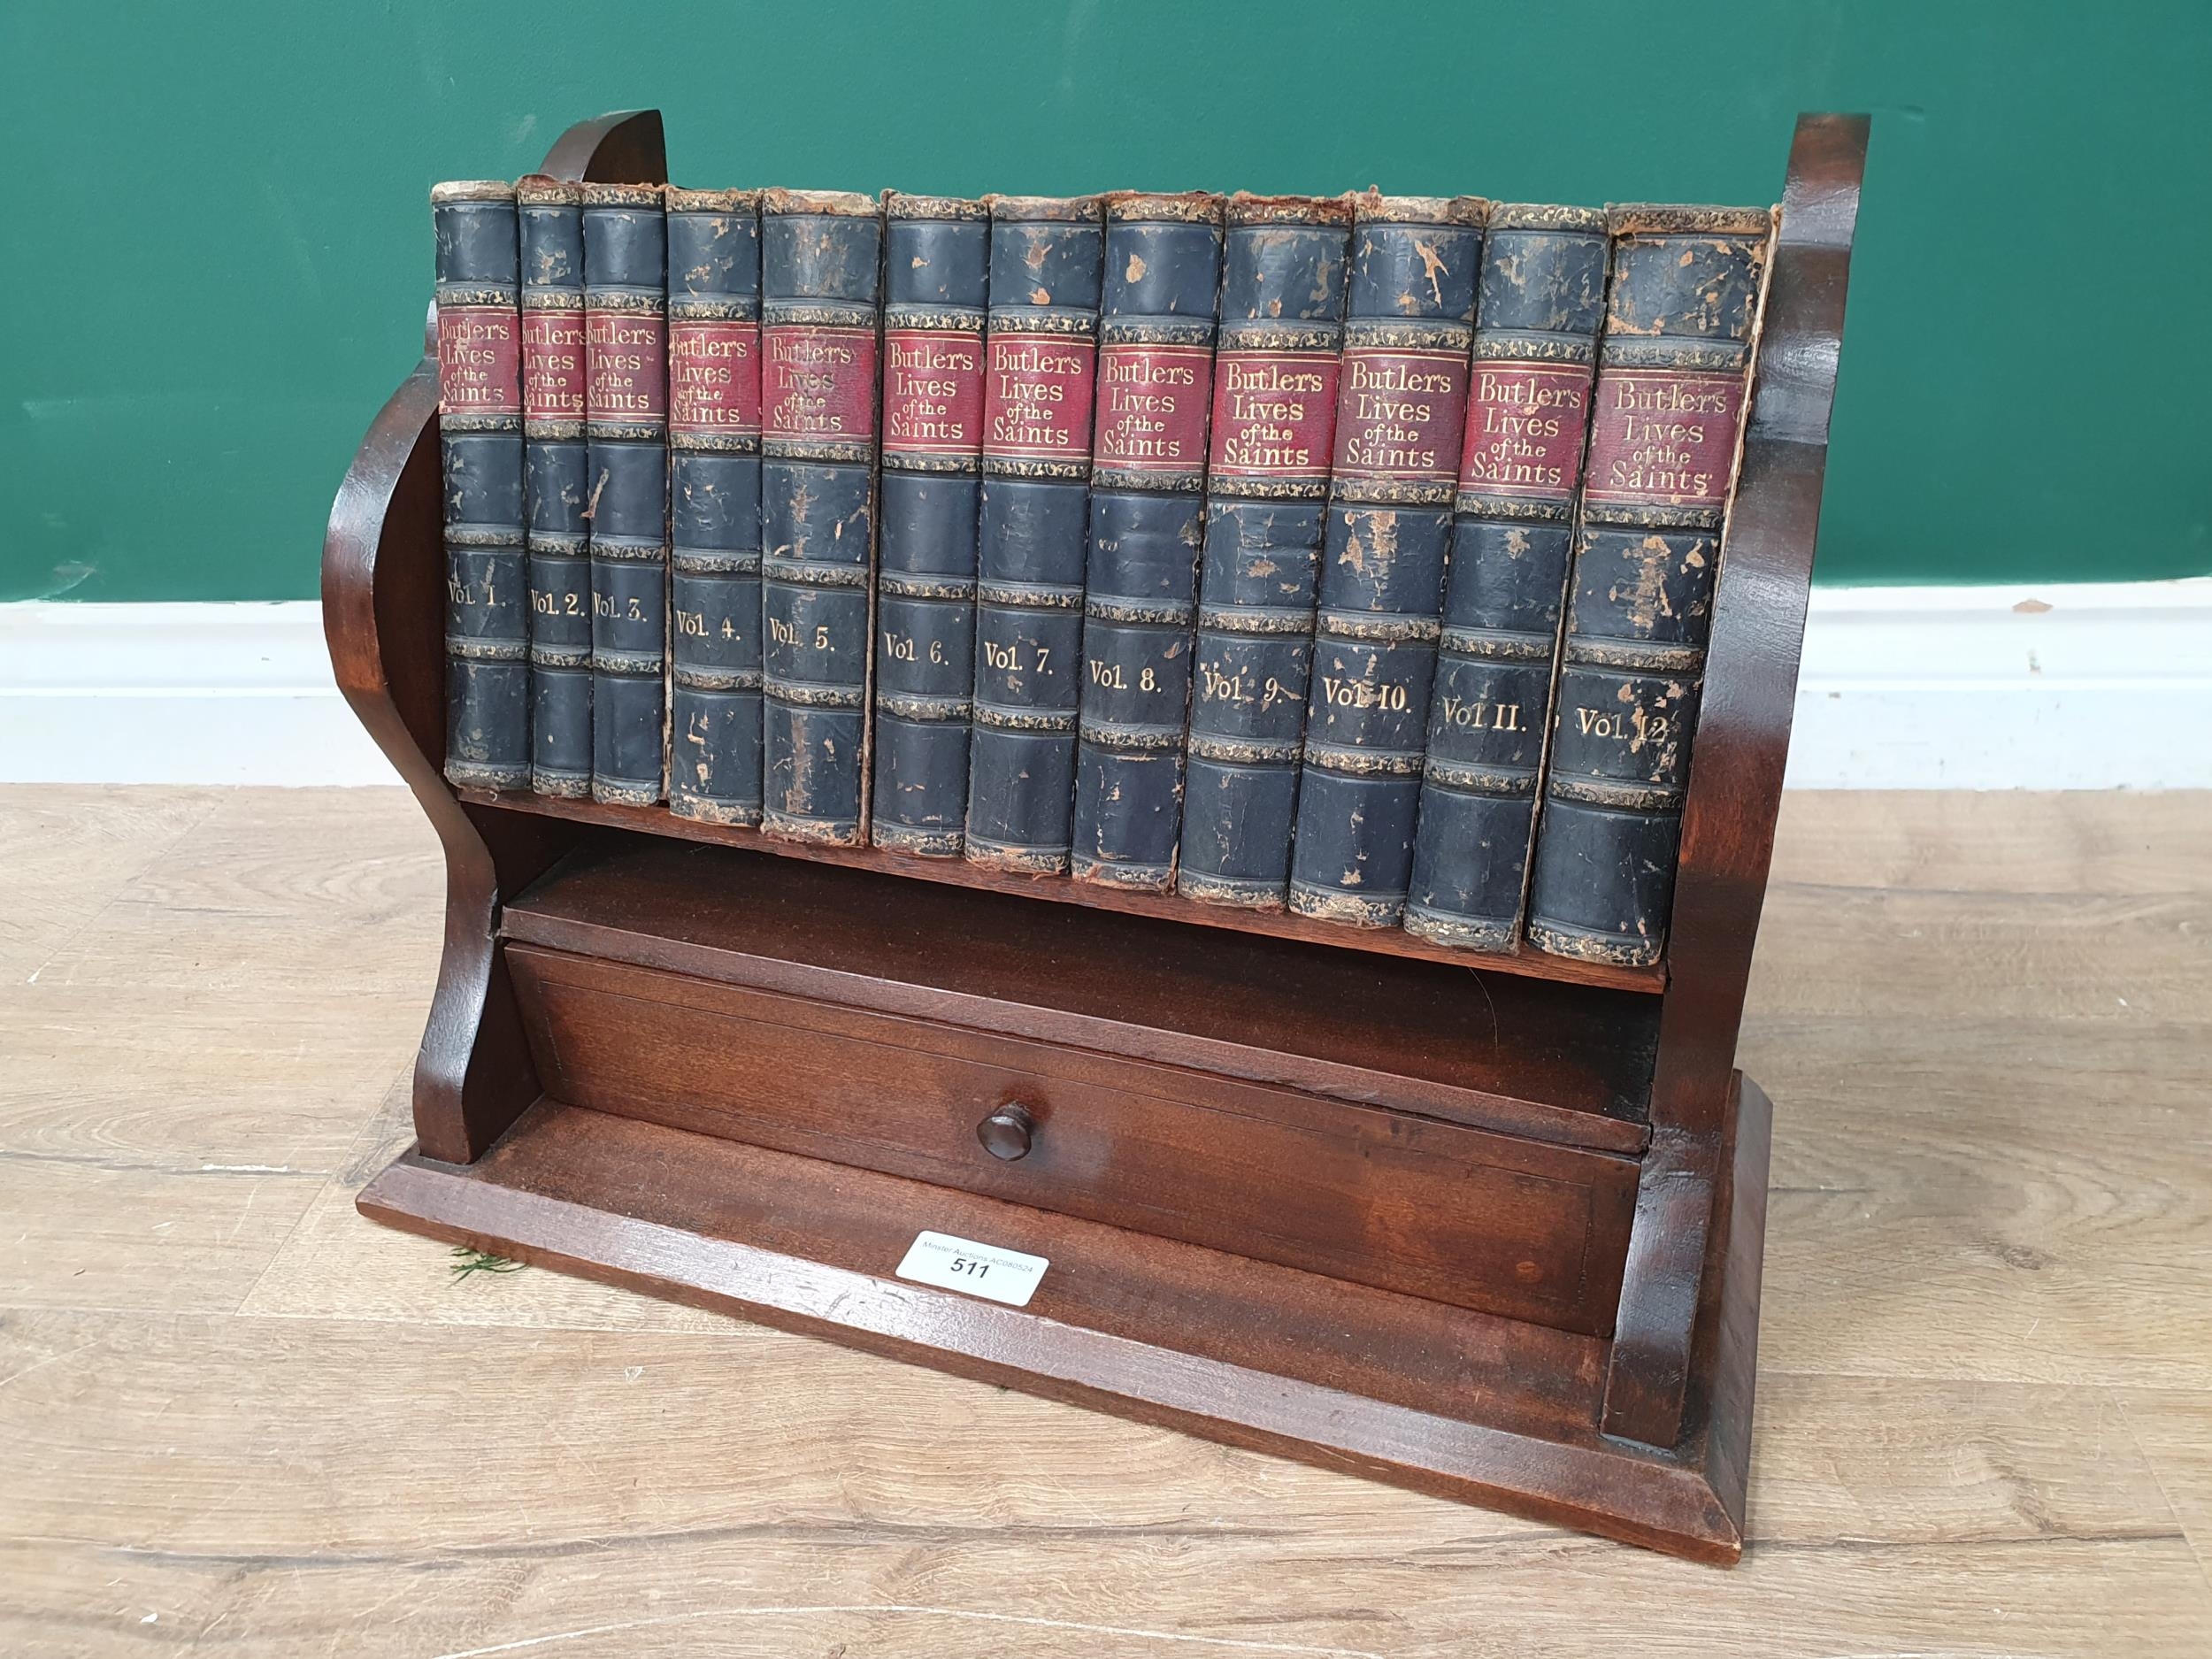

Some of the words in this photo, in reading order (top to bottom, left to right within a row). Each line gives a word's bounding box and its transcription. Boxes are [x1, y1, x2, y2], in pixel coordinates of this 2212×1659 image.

[446, 344, 495, 365] Lives
[525, 348, 574, 370] Lives
[591, 348, 641, 370] Lives
[451, 366, 463, 387] of
[464, 367, 488, 381] the
[528, 373, 541, 391] of
[541, 373, 567, 387] the
[595, 373, 608, 392] of
[608, 373, 634, 387] the
[676, 361, 732, 384] Lives
[779, 366, 834, 390] Lives
[443, 380, 503, 402] Saints
[525, 386, 584, 408] Saints
[696, 385, 723, 401] the
[896, 373, 956, 397] Lives
[1000, 375, 1063, 402] Lives
[589, 386, 649, 409] Saints
[784, 392, 798, 411] of
[799, 393, 826, 409] the
[902, 400, 918, 419] of
[919, 401, 947, 415] the
[1110, 388, 1175, 413] Lives
[1233, 395, 1304, 420] Lives
[1356, 394, 1431, 421] Lives
[673, 398, 741, 423] Saints
[773, 405, 842, 431] Saints
[1007, 403, 1023, 424] of
[1025, 403, 1053, 420] the
[1484, 407, 1559, 437] Lives
[891, 412, 964, 439] Saints
[994, 417, 1069, 445] Saints
[1118, 415, 1135, 437] of
[1136, 416, 1165, 432] the
[1241, 424, 1259, 447] of
[1261, 424, 1293, 441] the
[1364, 424, 1385, 446] of
[1386, 425, 1418, 442] the
[1623, 415, 1704, 442] Lives
[1103, 430, 1180, 457] Saints
[1225, 438, 1309, 465] Saints
[1347, 438, 1434, 467] Saints
[1491, 439, 1512, 461] of
[1513, 440, 1547, 457] the
[1632, 445, 1655, 465] of
[1657, 445, 1691, 464] the
[1471, 452, 1561, 484] Saints
[1610, 460, 1708, 490] Saints
[532, 589, 559, 614] Vol.
[565, 594, 585, 616] 2.
[593, 591, 621, 618] Vol.
[628, 598, 648, 623] 3.
[677, 610, 709, 636] Vol.
[721, 617, 741, 641] 4.
[815, 626, 835, 651] 5.
[930, 641, 949, 665] 6.
[985, 641, 1023, 671] Vol.
[1036, 649, 1053, 675] 7.
[1090, 660, 1127, 689] Vol.
[1141, 668, 1162, 693] 8.
[1263, 677, 1282, 703] 9.
[1576, 708, 1628, 741] Vol.
[922, 1241, 954, 1254] Minster
[953, 1248, 988, 1263] Auctions
[950, 1257, 990, 1279] 511
